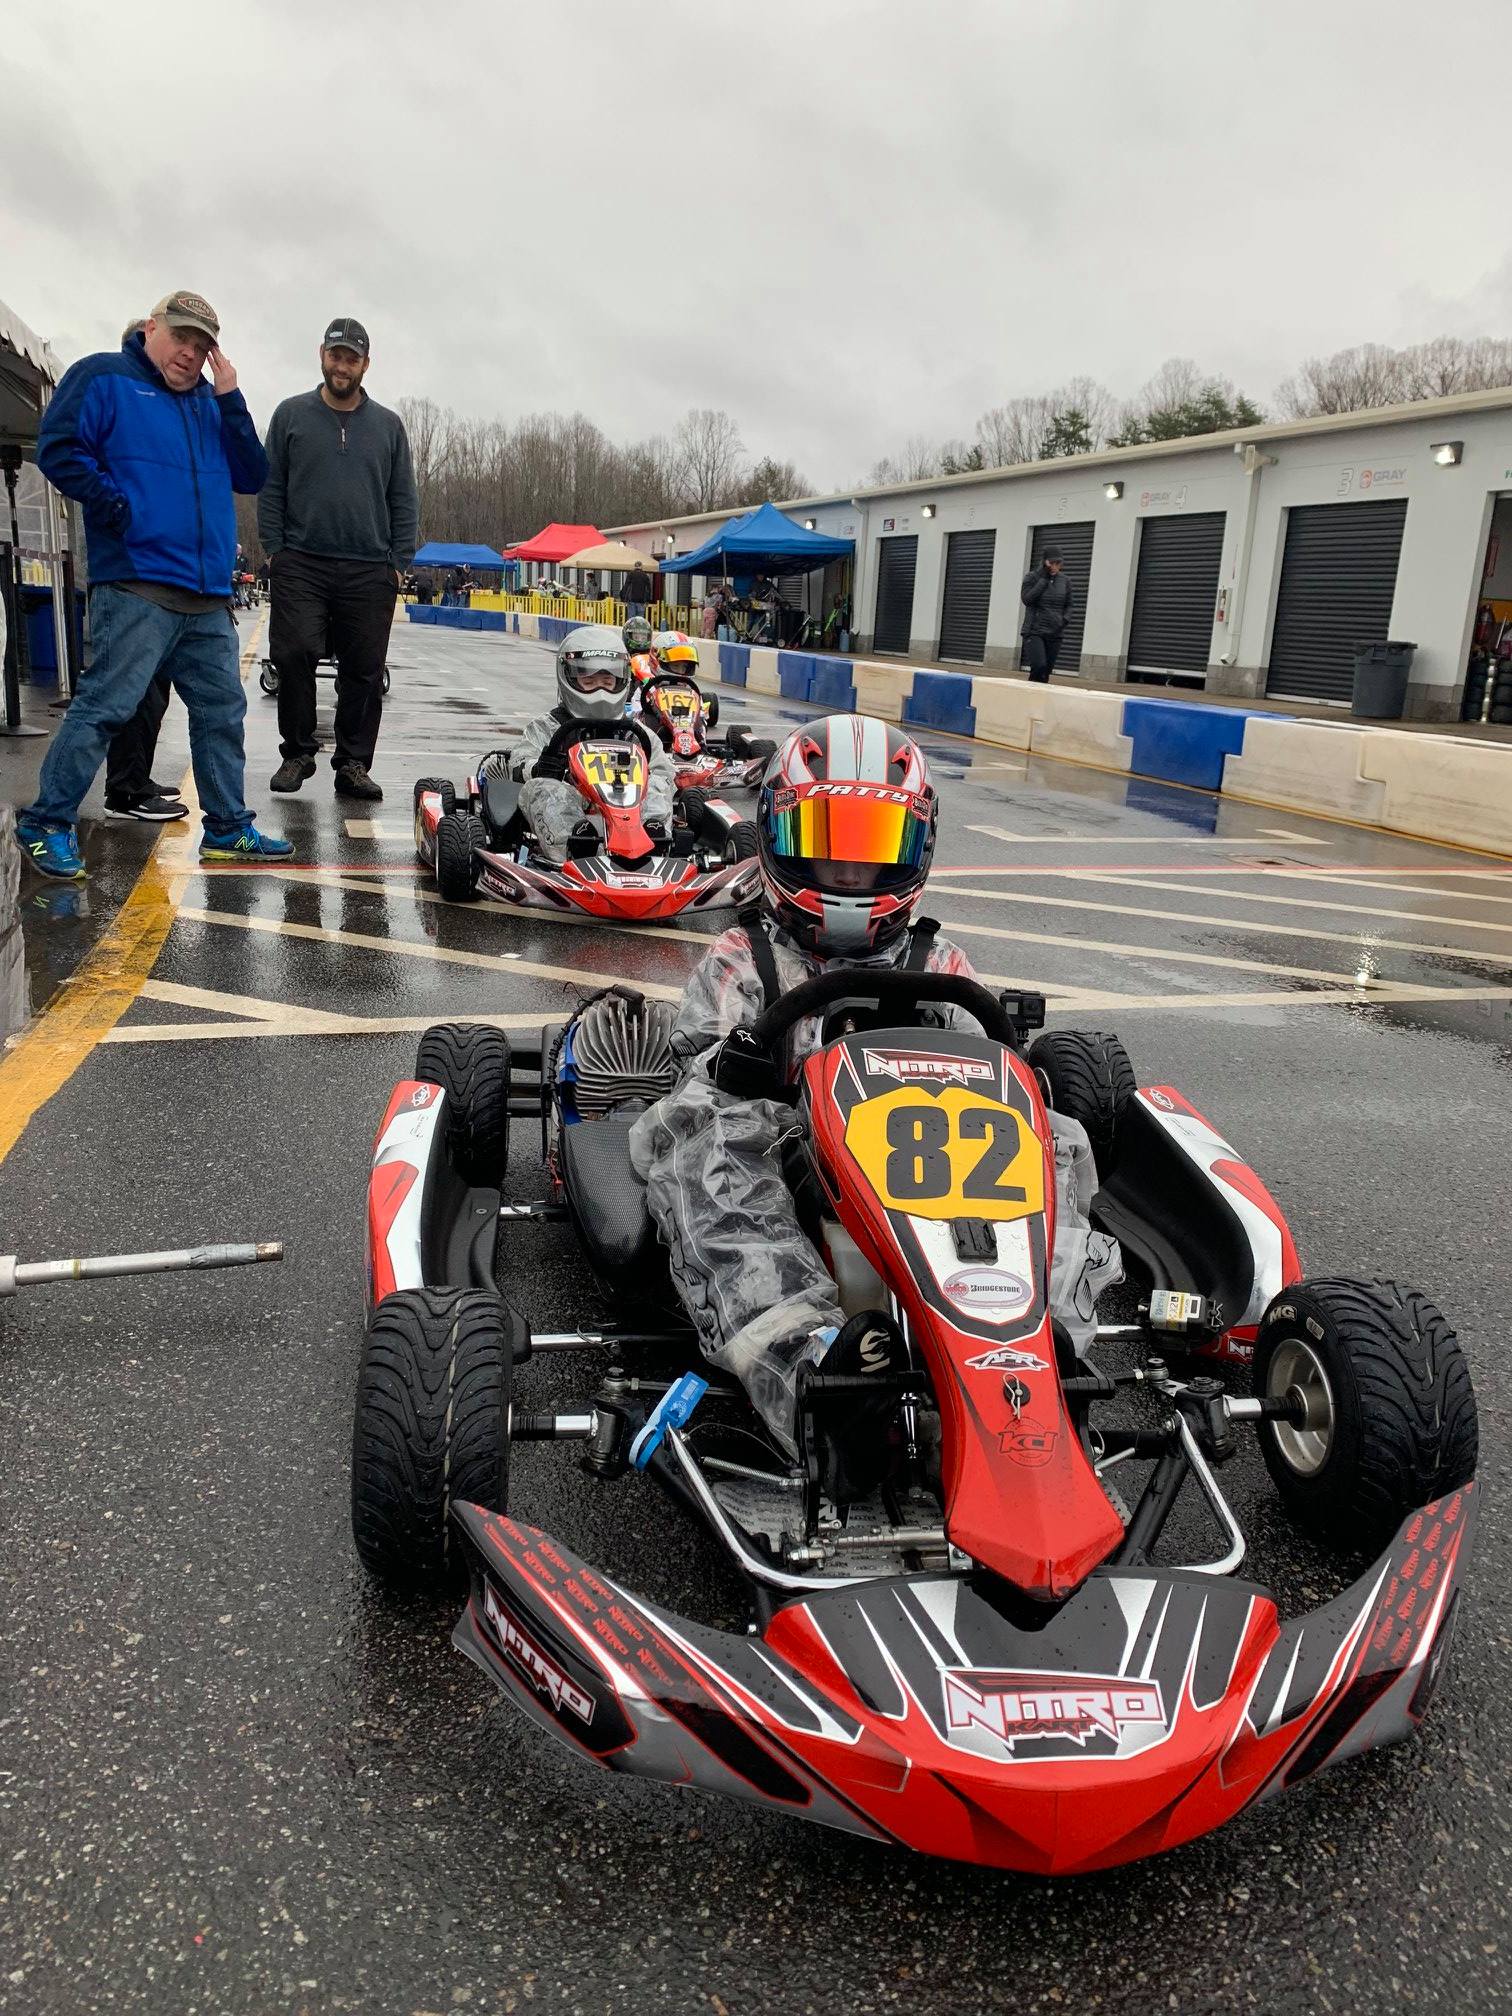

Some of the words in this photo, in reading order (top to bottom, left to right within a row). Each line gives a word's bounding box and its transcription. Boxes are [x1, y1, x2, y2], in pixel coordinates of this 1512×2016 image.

[1373, 468, 1408, 482] GRAY
[581, 650, 619, 658] IMPACT
[805, 784, 910, 803] PATTY
[864, 1050, 994, 1085] NITRO
[886, 1105, 1028, 1203] 82
[969, 1283, 1021, 1294] BRIDGESTONE
[1269, 1304, 1297, 1326] MG
[485, 1583, 595, 1722] NITRO
[942, 1672, 1168, 1746] NITRO
